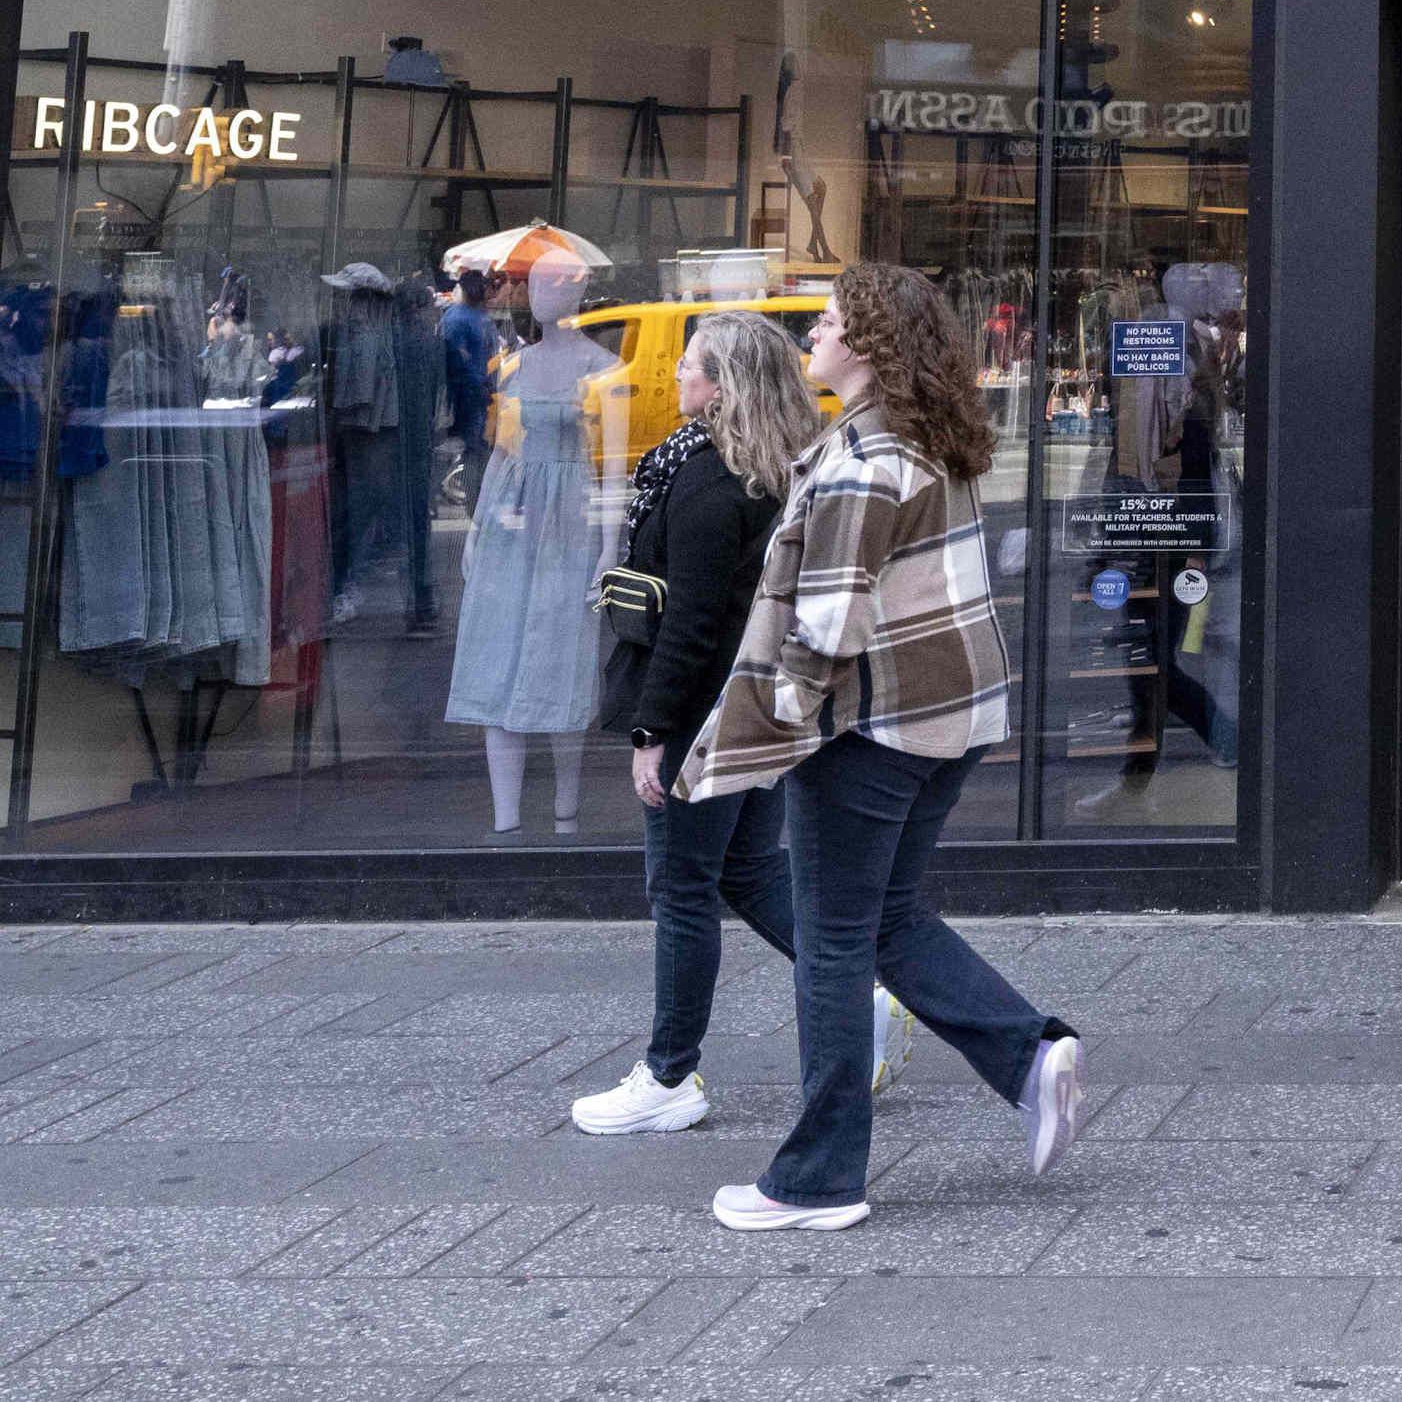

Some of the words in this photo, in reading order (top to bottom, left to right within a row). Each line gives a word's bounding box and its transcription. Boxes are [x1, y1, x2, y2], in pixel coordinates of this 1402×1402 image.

[33, 96, 301, 161] RIBCAGE
[1126, 327, 1139, 336] NO
[1140, 327, 1172, 335] PUBLIC
[1122, 336, 1175, 345] RESTROOMS
[1117, 353, 1129, 362] NO
[1131, 353, 1149, 361] HAY
[1119, 499, 1146, 510] 15%
[1149, 499, 1175, 510] OFF
[1070, 513, 1112, 522] AVAILABLE
[1114, 513, 1130, 522] FOR
[1175, 513, 1215, 522] STUDENTS
[1105, 523, 1140, 532] MILITARY
[1142, 523, 1187, 532] PERSONNEL
